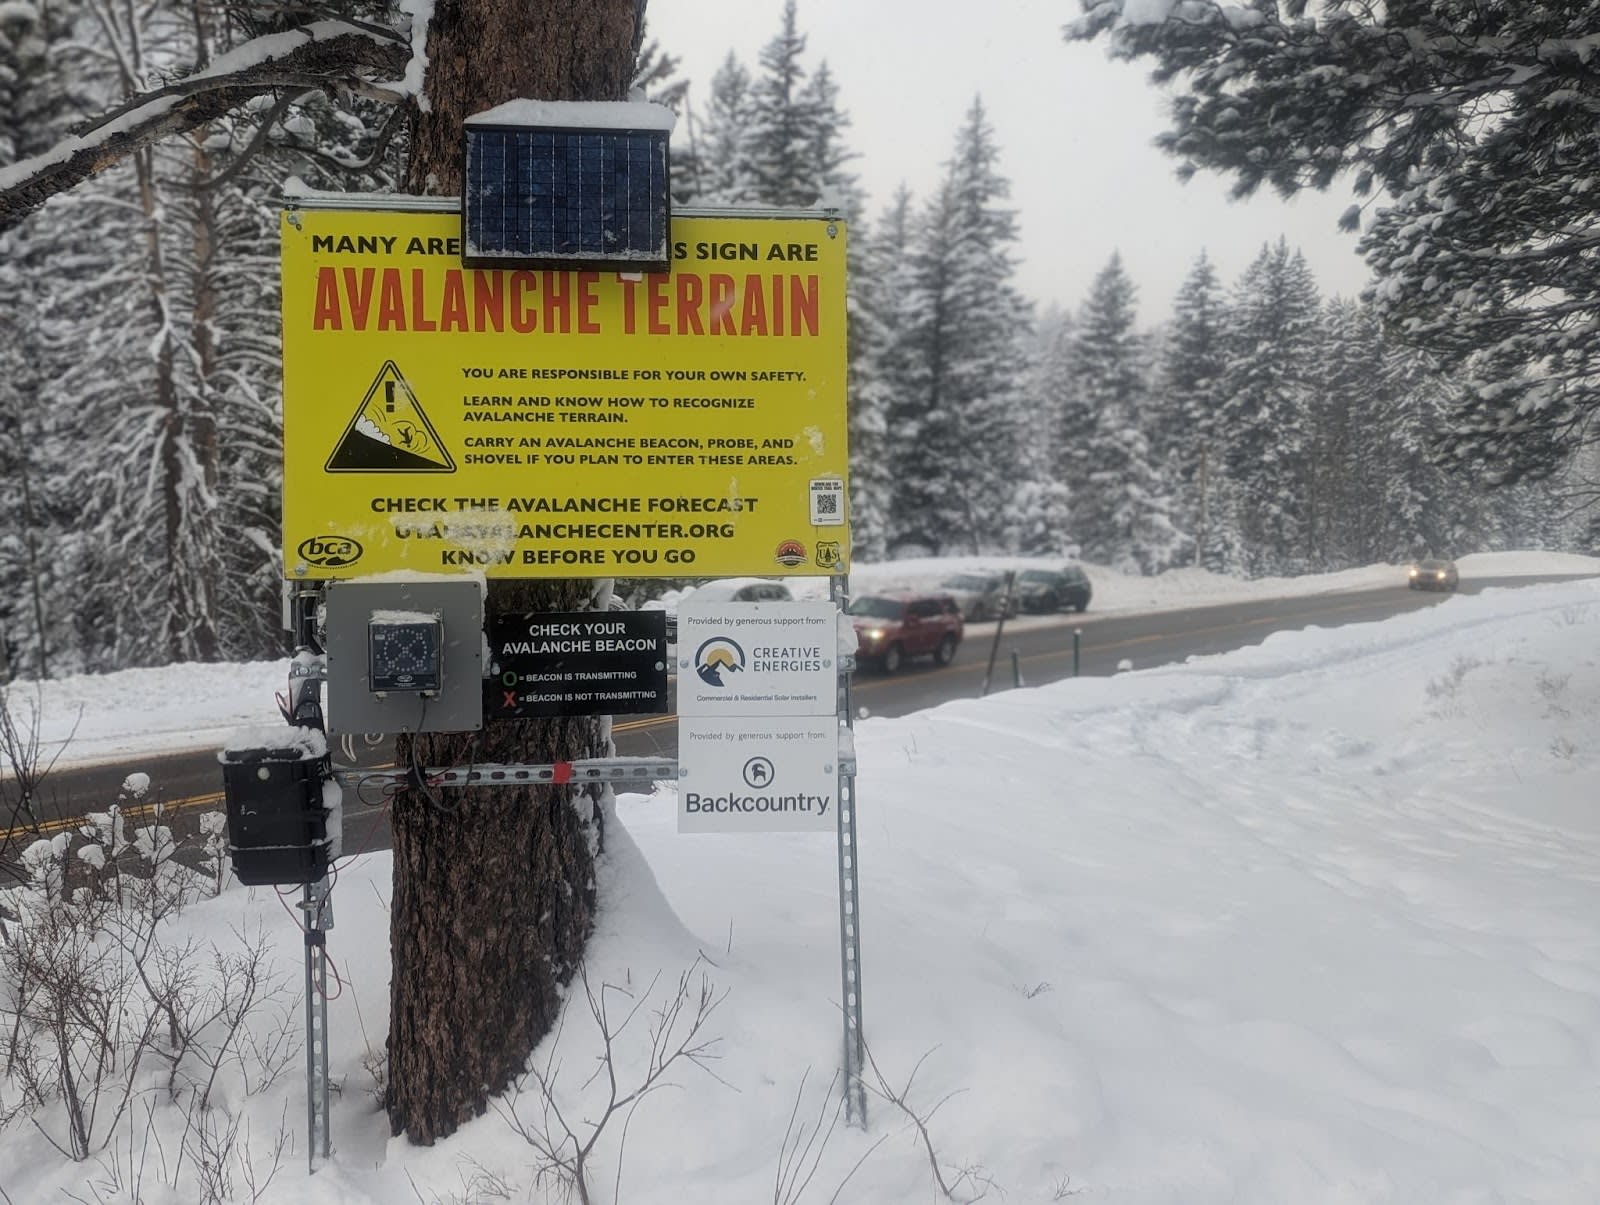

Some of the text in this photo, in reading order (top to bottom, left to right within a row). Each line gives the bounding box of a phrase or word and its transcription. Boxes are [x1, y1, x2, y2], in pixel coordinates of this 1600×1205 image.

[312, 235, 397, 254] MANY
[405, 237, 459, 255] ARE
[696, 243, 757, 260] SIGN
[766, 244, 818, 261] ARE
[313, 267, 819, 336] AVALANCHE TERRAIN
[462, 368, 806, 381] YOU ARE RESPONSIBLE FOR YOUR OWN SAFETY.
[464, 397, 754, 408] LEARN AND KNOW HOW TO RECOGNIZE
[463, 412, 628, 422] AVALANCHE TERRAIN.
[464, 438, 794, 450] CARRY AN AVALANCHE BEACON, PROBE, AND
[465, 454, 797, 465] SHOVEL IF YOU PLAN TO ENTER THESE AREAS.
[371, 498, 758, 512] CHECK THE AVALANCHE FORECAST
[308, 536, 352, 555] bca
[442, 550, 695, 565] KNOW BEFORE YOU GO
[725, 617, 734, 626] by
[736, 618, 771, 626] generous
[774, 618, 804, 626] support
[529, 623, 626, 636] CHECK YOUR
[502, 639, 657, 654] AVALANCHE BEACON
[753, 648, 820, 658] CREATIVE
[754, 661, 820, 671] ENERGIES
[526, 674, 562, 682] BEACON
[565, 673, 572, 681] IS
[575, 672, 637, 680] TRANSMITTING
[526, 694, 562, 702] BEACON
[565, 693, 572, 701] IS
[595, 691, 656, 700] TRANSMITTING
[726, 733, 734, 741] by
[739, 733, 772, 741] generous
[776, 732, 804, 740] support
